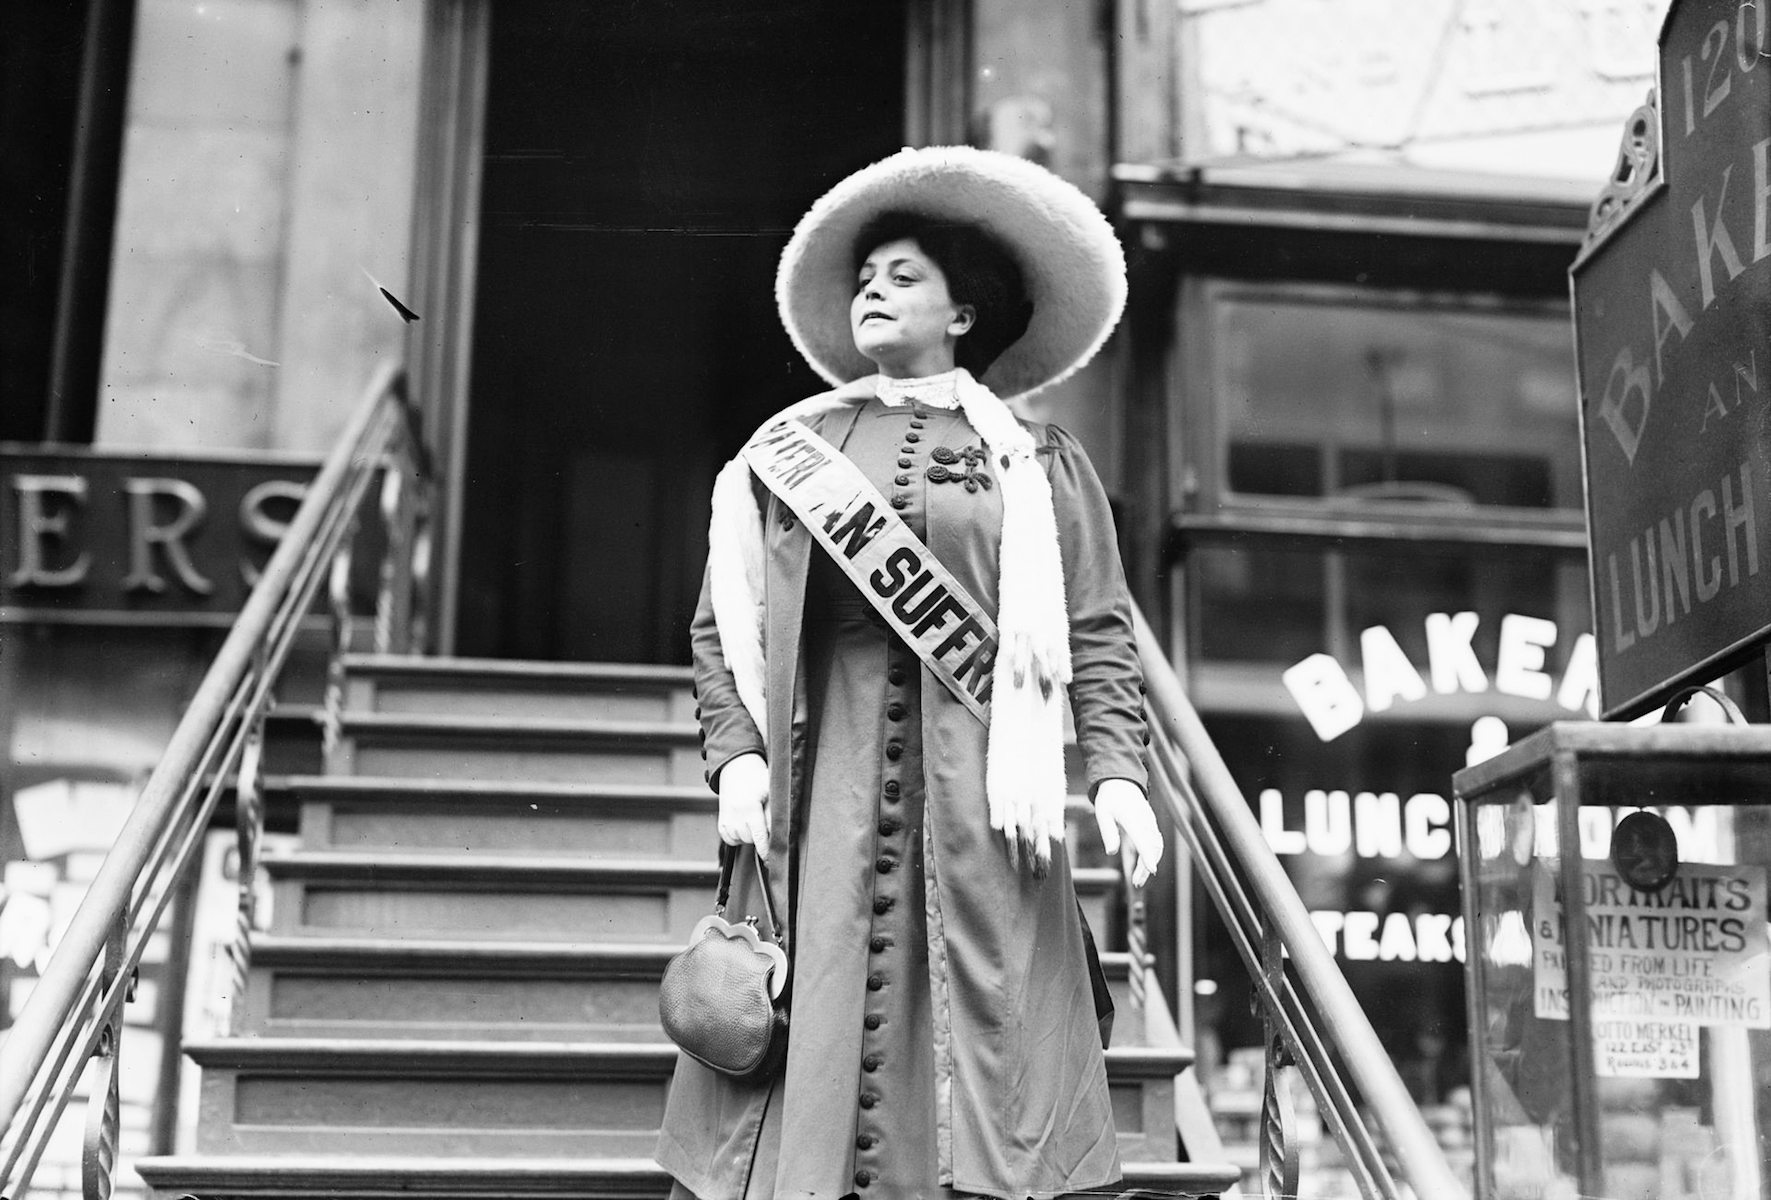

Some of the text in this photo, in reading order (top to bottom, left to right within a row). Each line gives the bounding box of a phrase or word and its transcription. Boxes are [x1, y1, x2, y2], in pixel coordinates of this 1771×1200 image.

[1682, 0, 1766, 137] 120
[7, 473, 312, 595] ERS
[1609, 461, 1759, 652] LUNCH
[1283, 909, 1467, 964] TEAK
[1539, 920, 1553, 940] &
[1597, 976, 1629, 989] AND
[1621, 955, 1665, 976] FROM
[1673, 957, 1714, 978] LIFE
[1675, 993, 1761, 1020] PAINTING
